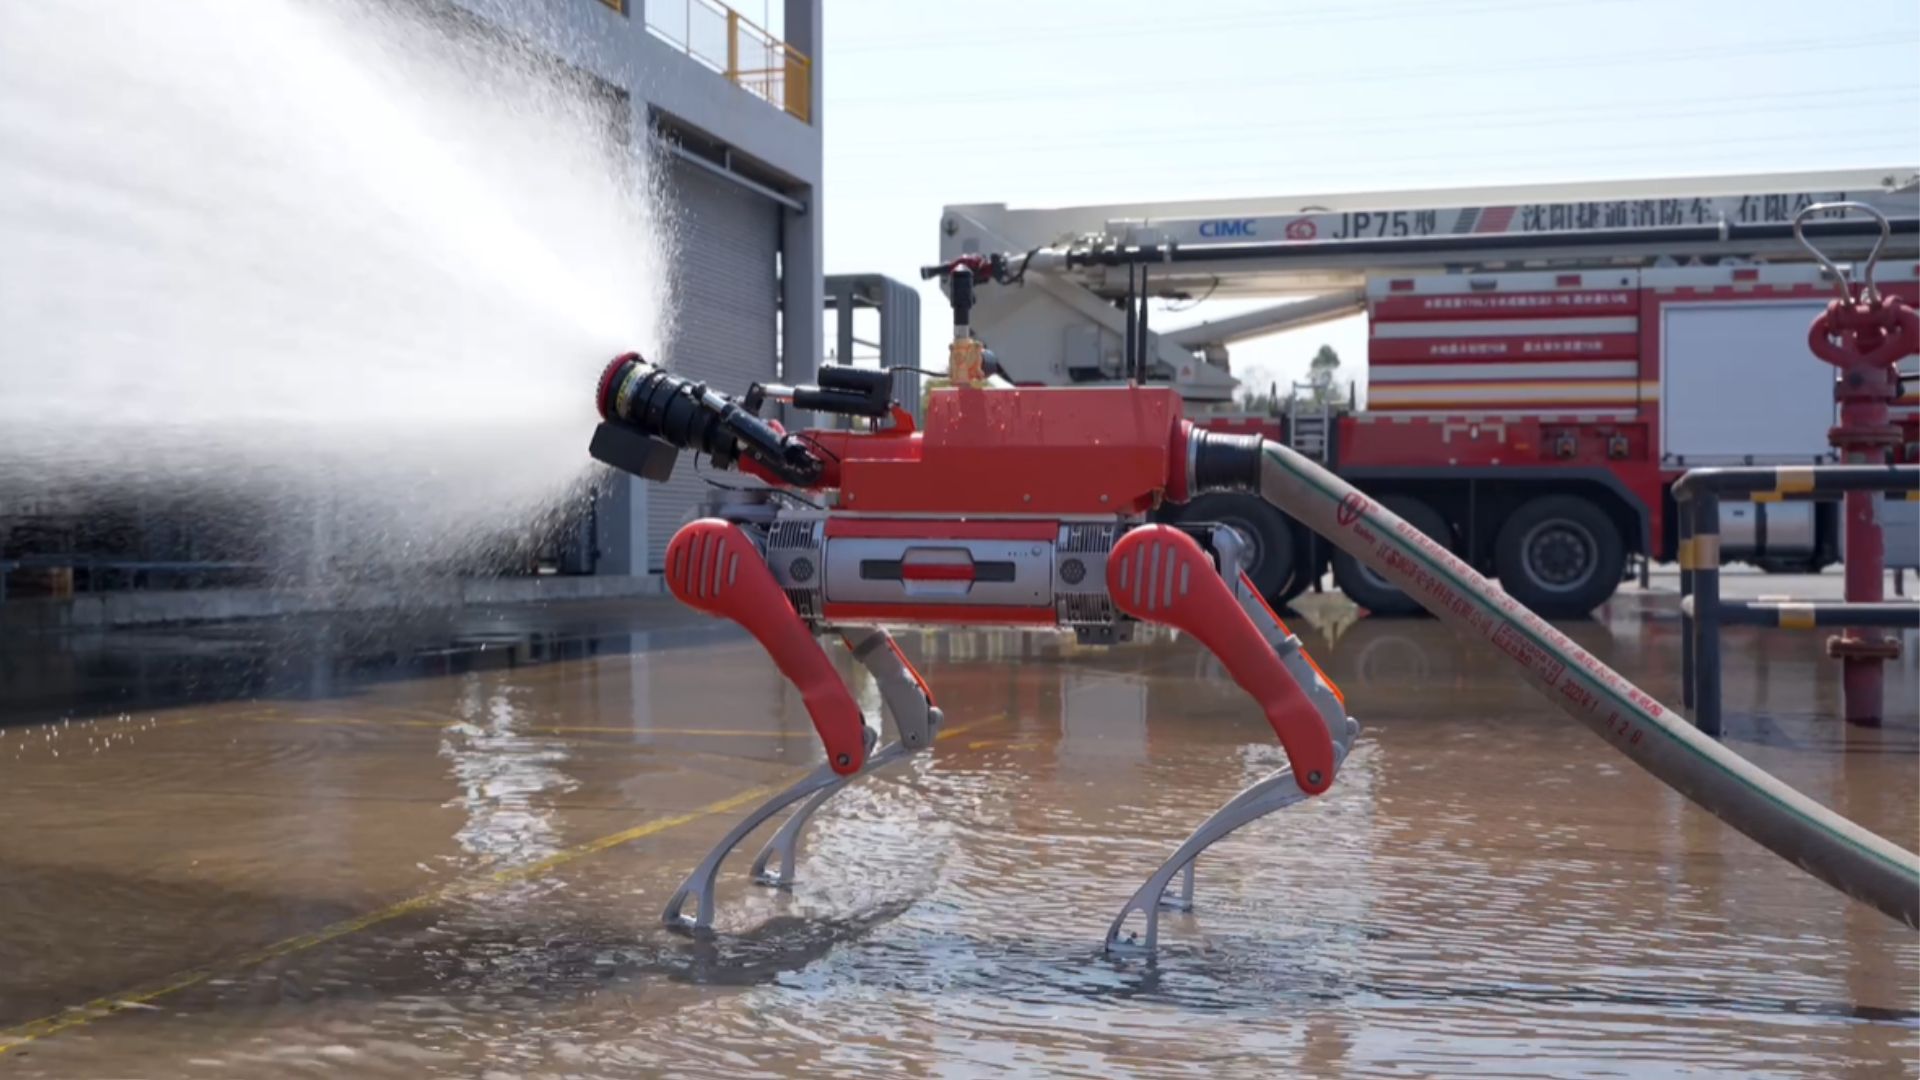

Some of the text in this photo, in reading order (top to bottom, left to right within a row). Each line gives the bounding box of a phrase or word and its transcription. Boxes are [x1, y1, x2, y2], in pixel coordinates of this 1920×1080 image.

[1522, 197, 1712, 231] 沈阳捷通消防车
[1199, 219, 1257, 237] CIMC
